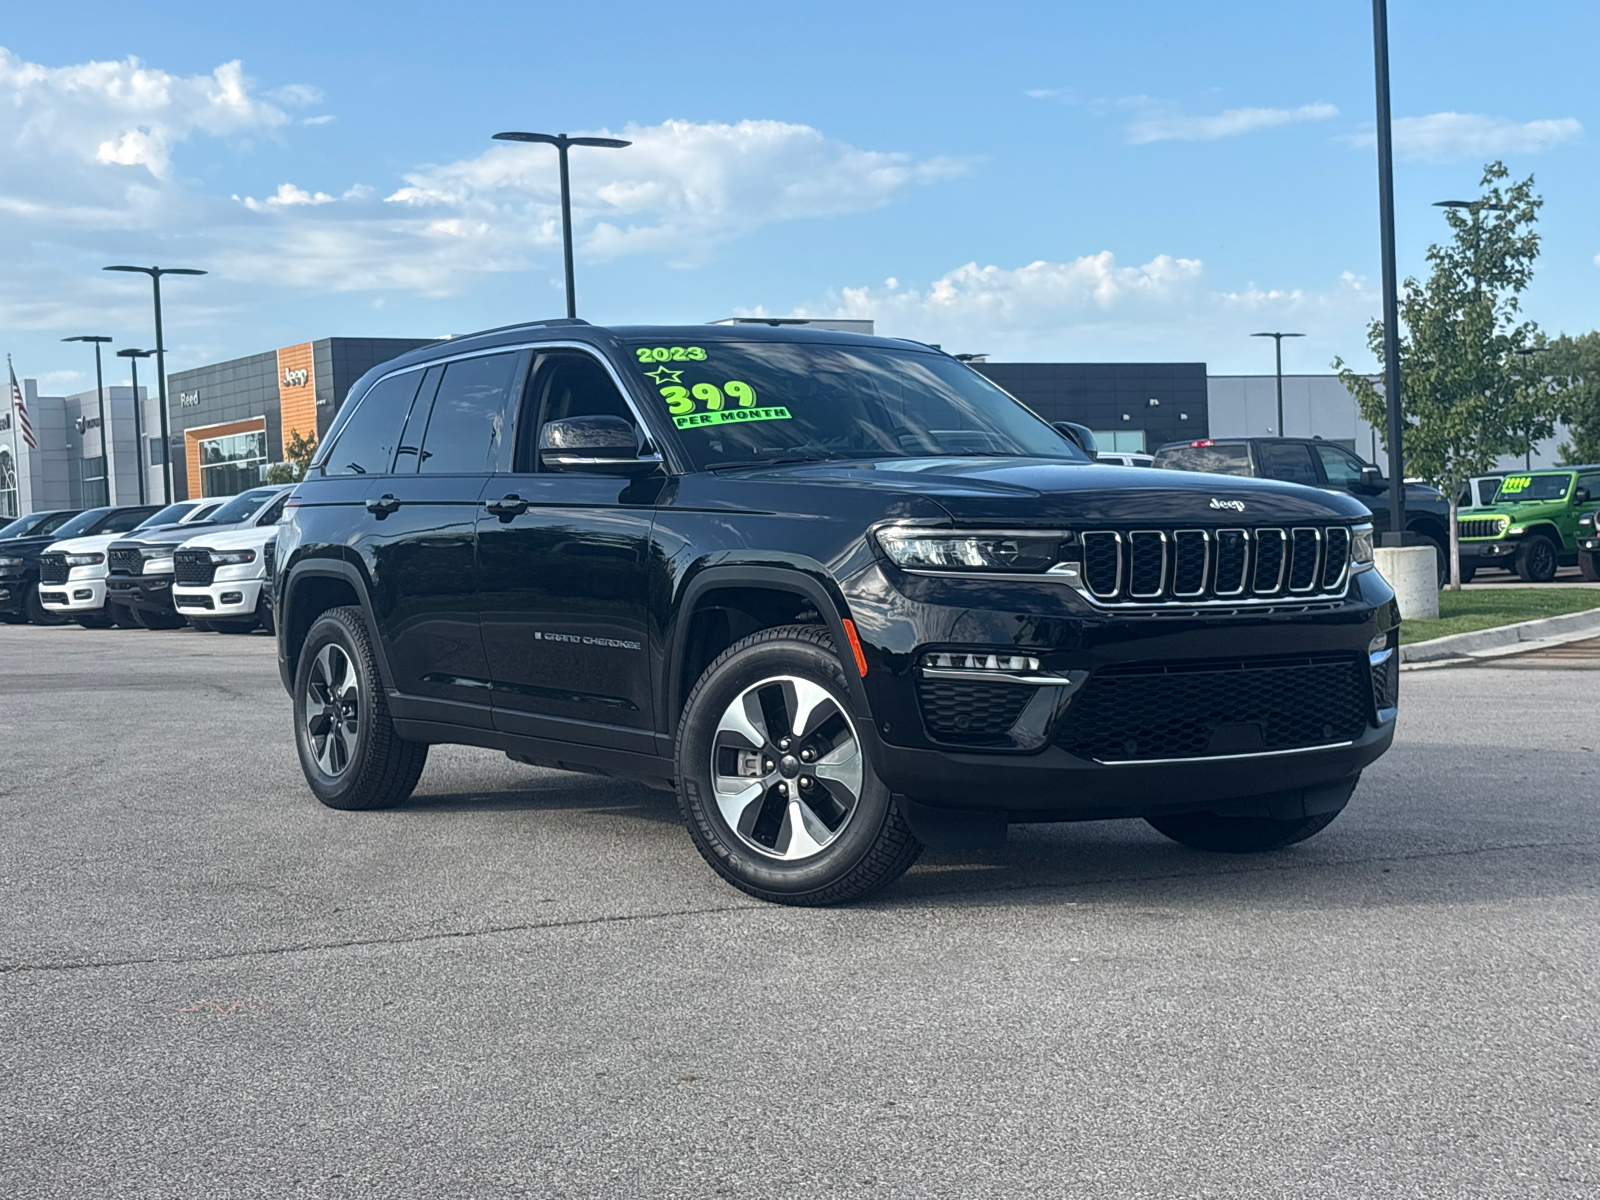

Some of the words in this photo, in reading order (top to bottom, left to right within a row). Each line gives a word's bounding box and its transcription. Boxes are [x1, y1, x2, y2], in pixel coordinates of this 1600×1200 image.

[636, 346, 707, 363] 2023
[284, 367, 308, 387] Jeep
[181, 389, 199, 408] Reed
[659, 381, 757, 415] 399
[676, 415, 712, 427] PER
[720, 409, 787, 421] MONTH
[1209, 498, 1245, 512] Jeep
[544, 632, 580, 643] GRAND
[582, 636, 641, 650] CHEROKEE
[685, 781, 729, 858] MICHELIN
